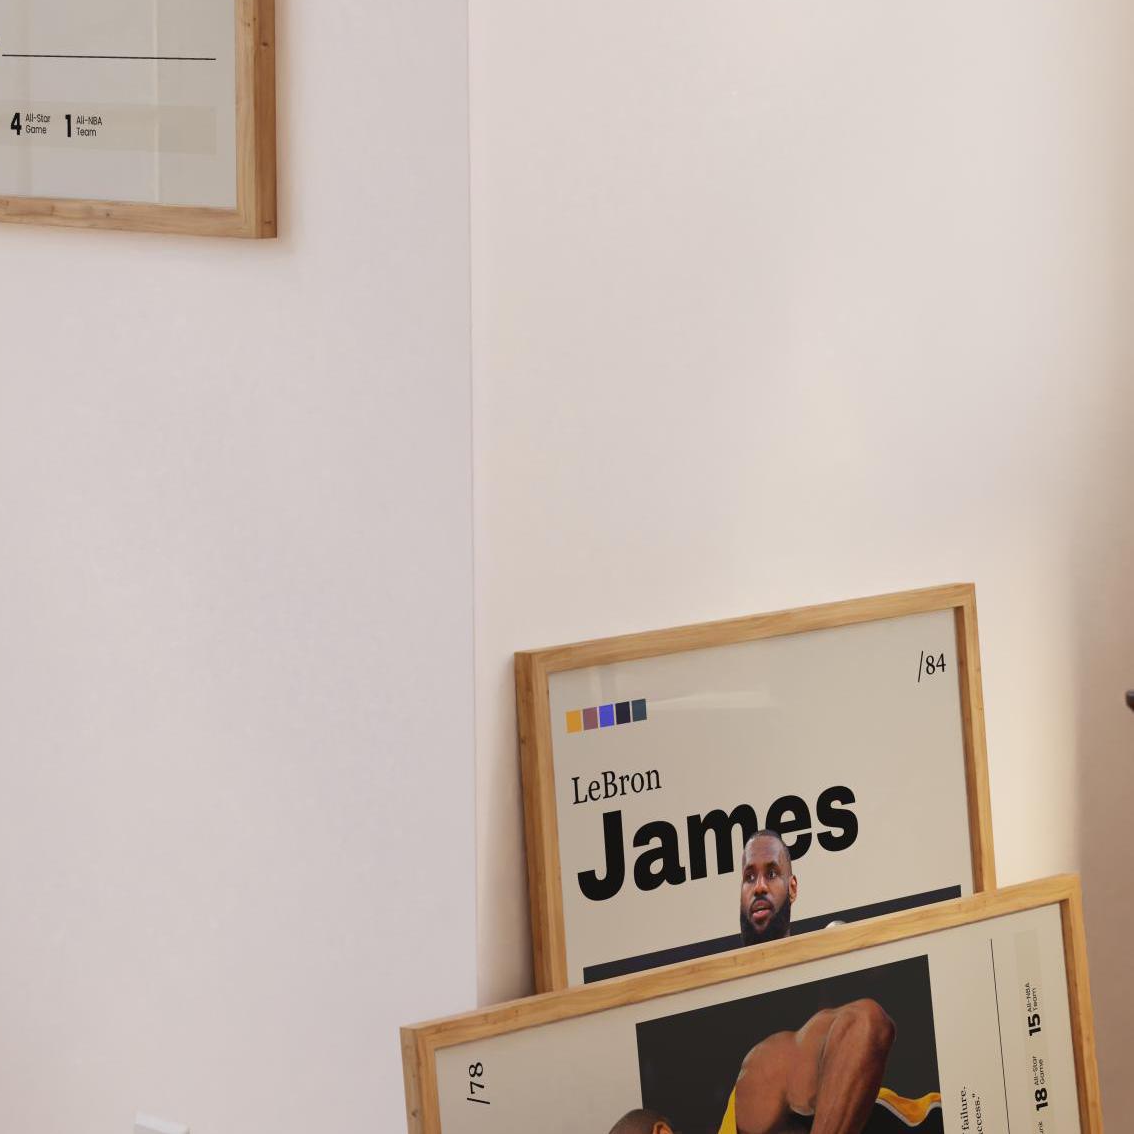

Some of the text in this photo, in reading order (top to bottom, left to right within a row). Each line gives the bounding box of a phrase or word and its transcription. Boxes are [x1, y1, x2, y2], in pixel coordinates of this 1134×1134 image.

[10, 112, 22, 136] 4
[25, 112, 51, 123] All-Star
[25, 124, 47, 134] Game
[65, 114, 71, 138] 1
[76, 115, 103, 126] All-NBA
[76, 127, 96, 137] Team
[917, 650, 947, 683] /84
[571, 768, 662, 805] LeBron
[577, 785, 859, 901] James
[1027, 1013, 1041, 1036] 15
[466, 1061, 491, 1105] /78
[960, 1085, 970, 1130] failure.
[1035, 1087, 1049, 1111] 18
